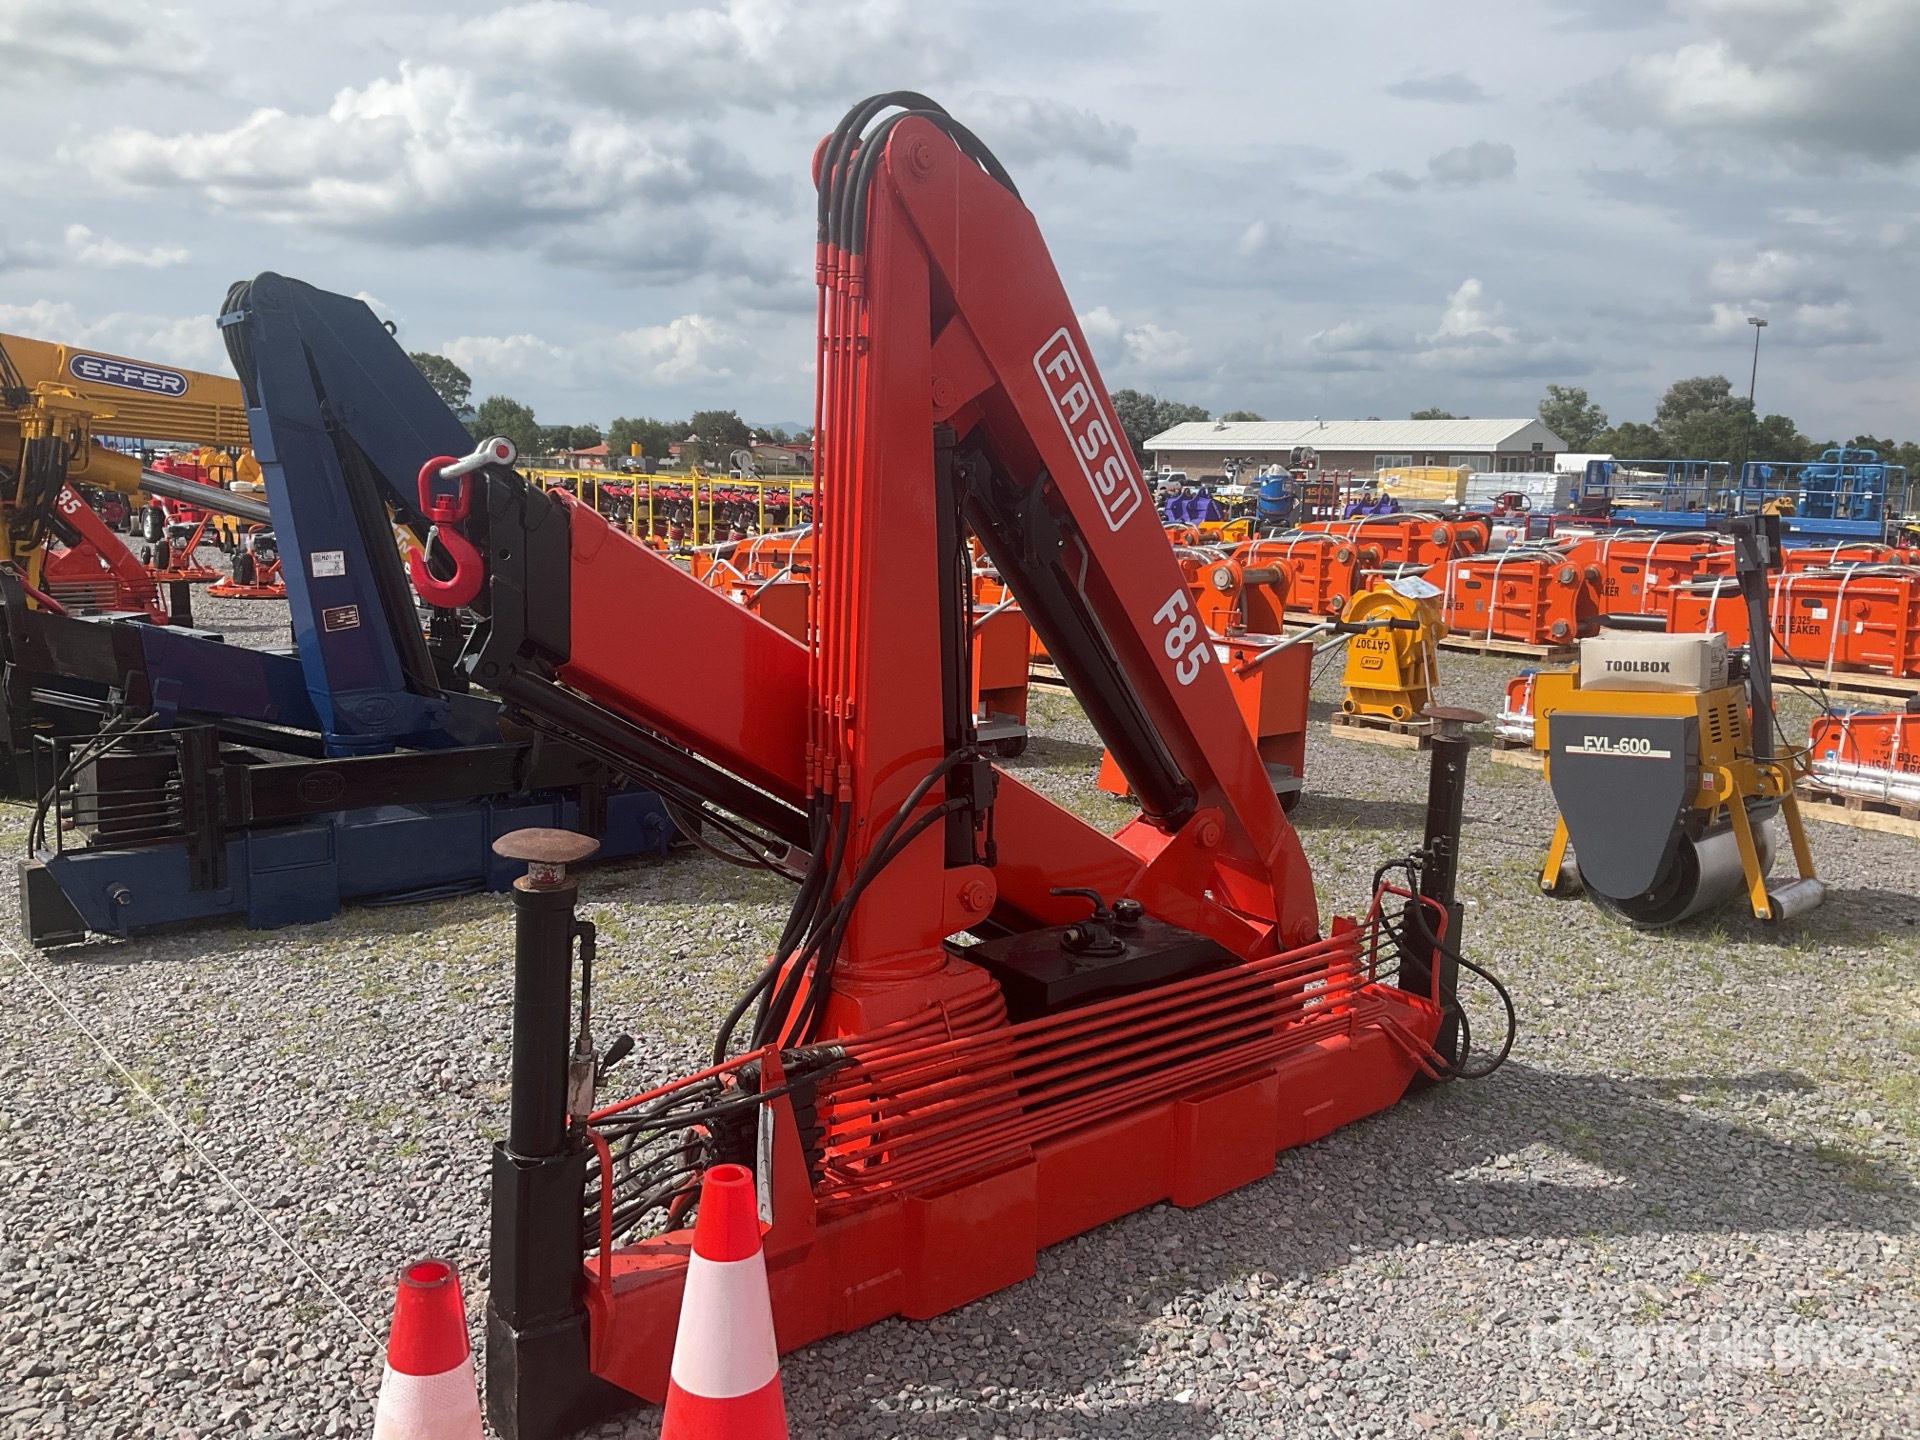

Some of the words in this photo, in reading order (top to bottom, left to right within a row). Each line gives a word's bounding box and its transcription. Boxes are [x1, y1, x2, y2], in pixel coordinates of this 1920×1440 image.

[78, 360, 181, 392] EFFER
[1045, 349, 1131, 513] FASSI
[54, 485, 82, 514] 85
[1152, 588, 1211, 686] F85
[1355, 638, 1390, 651] CAT307
[1605, 660, 1670, 673] TOOLBOX
[1583, 735, 1651, 754] FYL-600
[1883, 750, 1920, 765] JB3C
